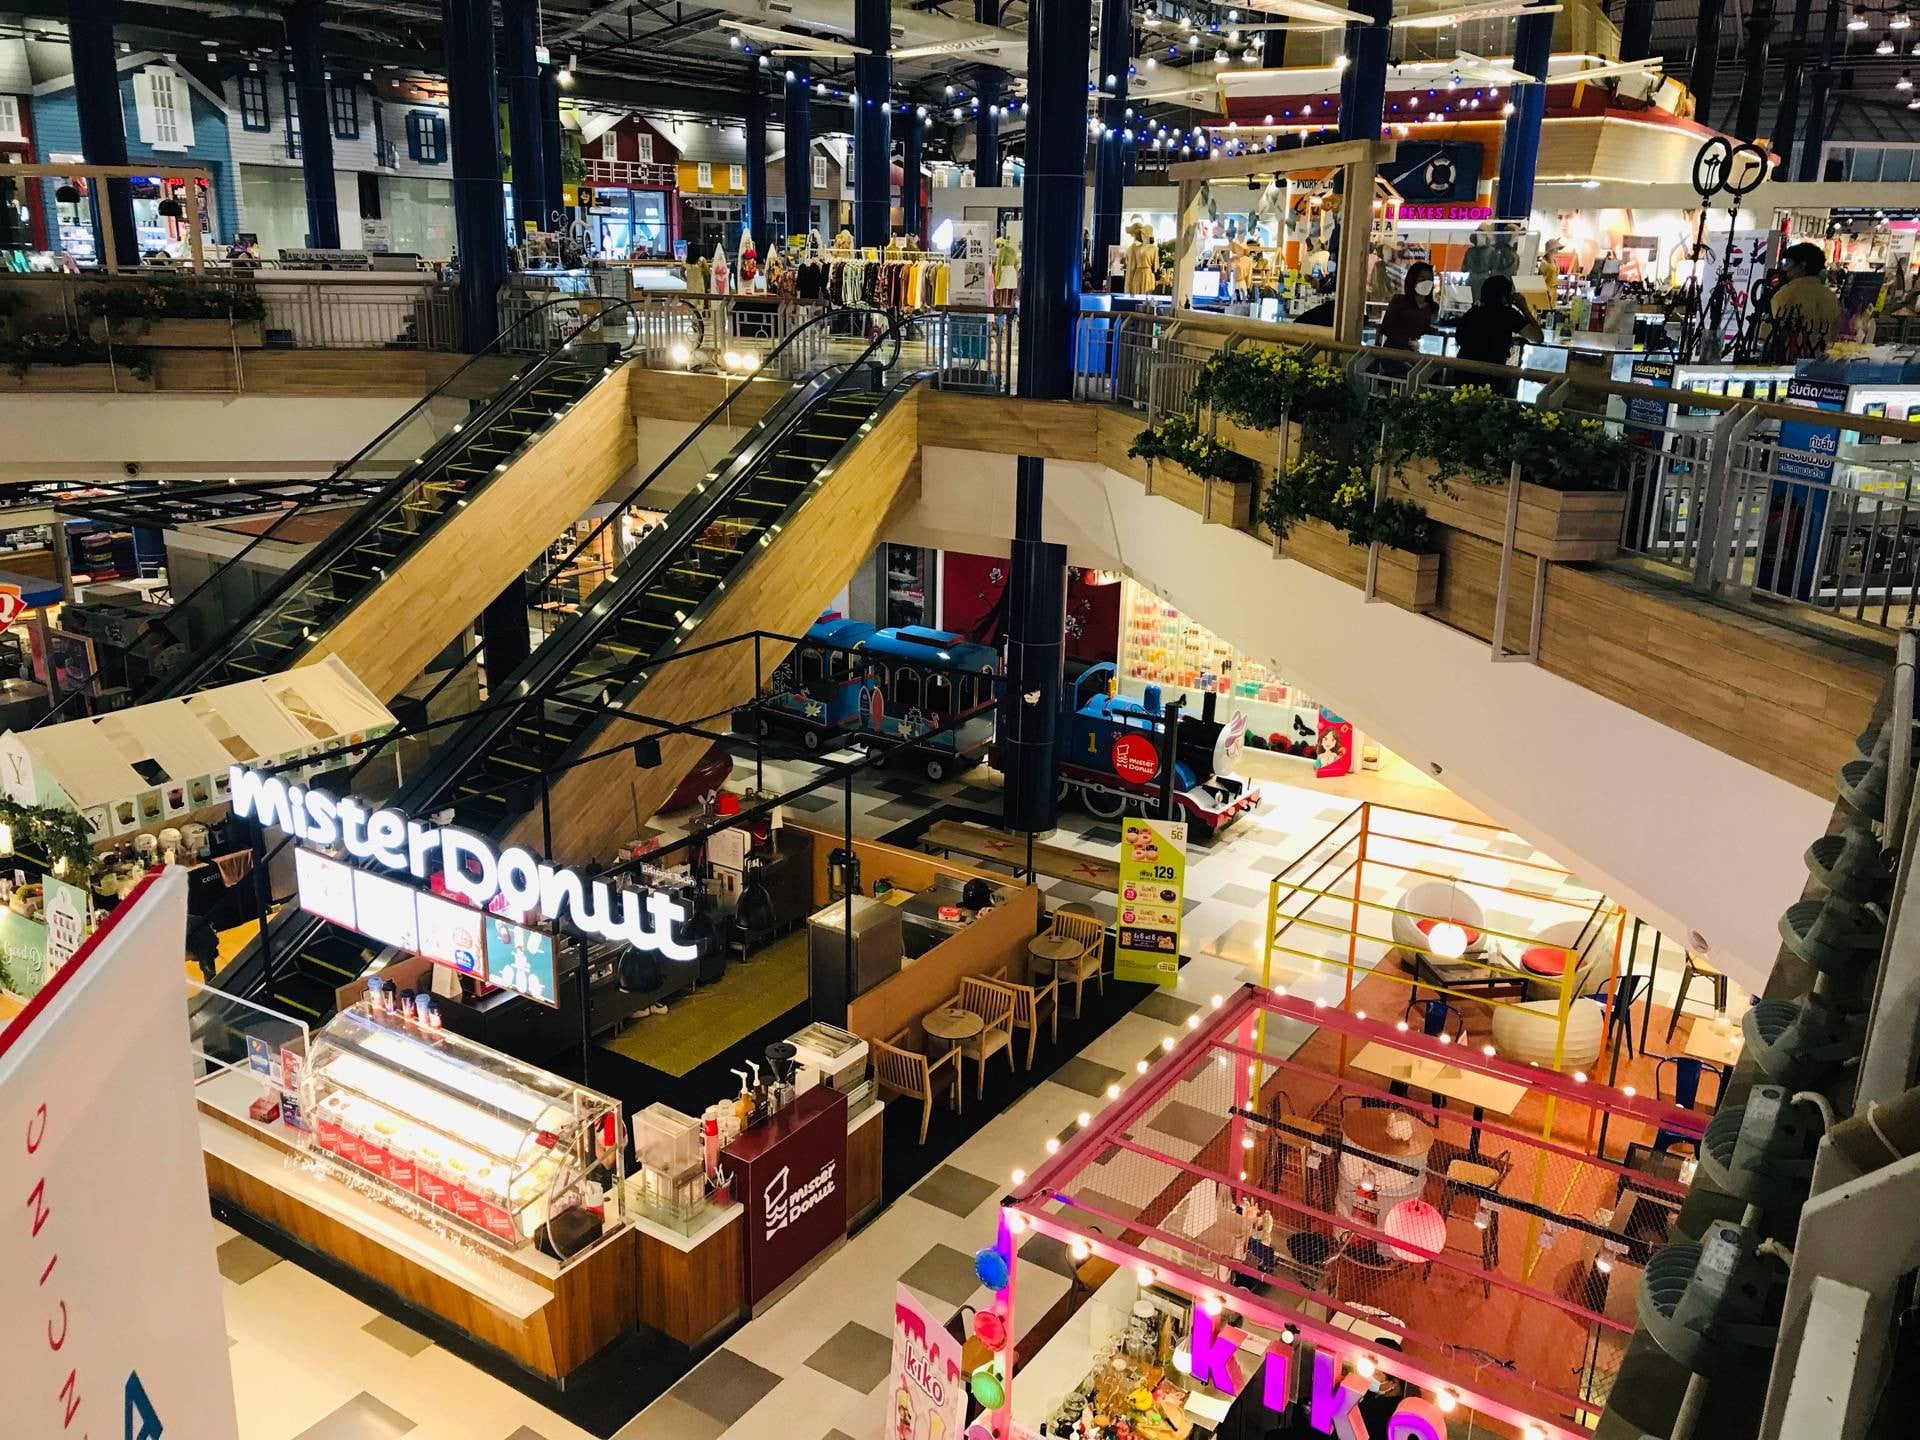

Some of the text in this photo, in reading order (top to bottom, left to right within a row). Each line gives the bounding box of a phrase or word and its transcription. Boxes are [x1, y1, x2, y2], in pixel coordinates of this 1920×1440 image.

[1449, 207, 1492, 219] SHOP
[1128, 764, 1154, 774] Donut
[1171, 831, 1183, 840] 5G
[789, 1180, 836, 1224] Donut
